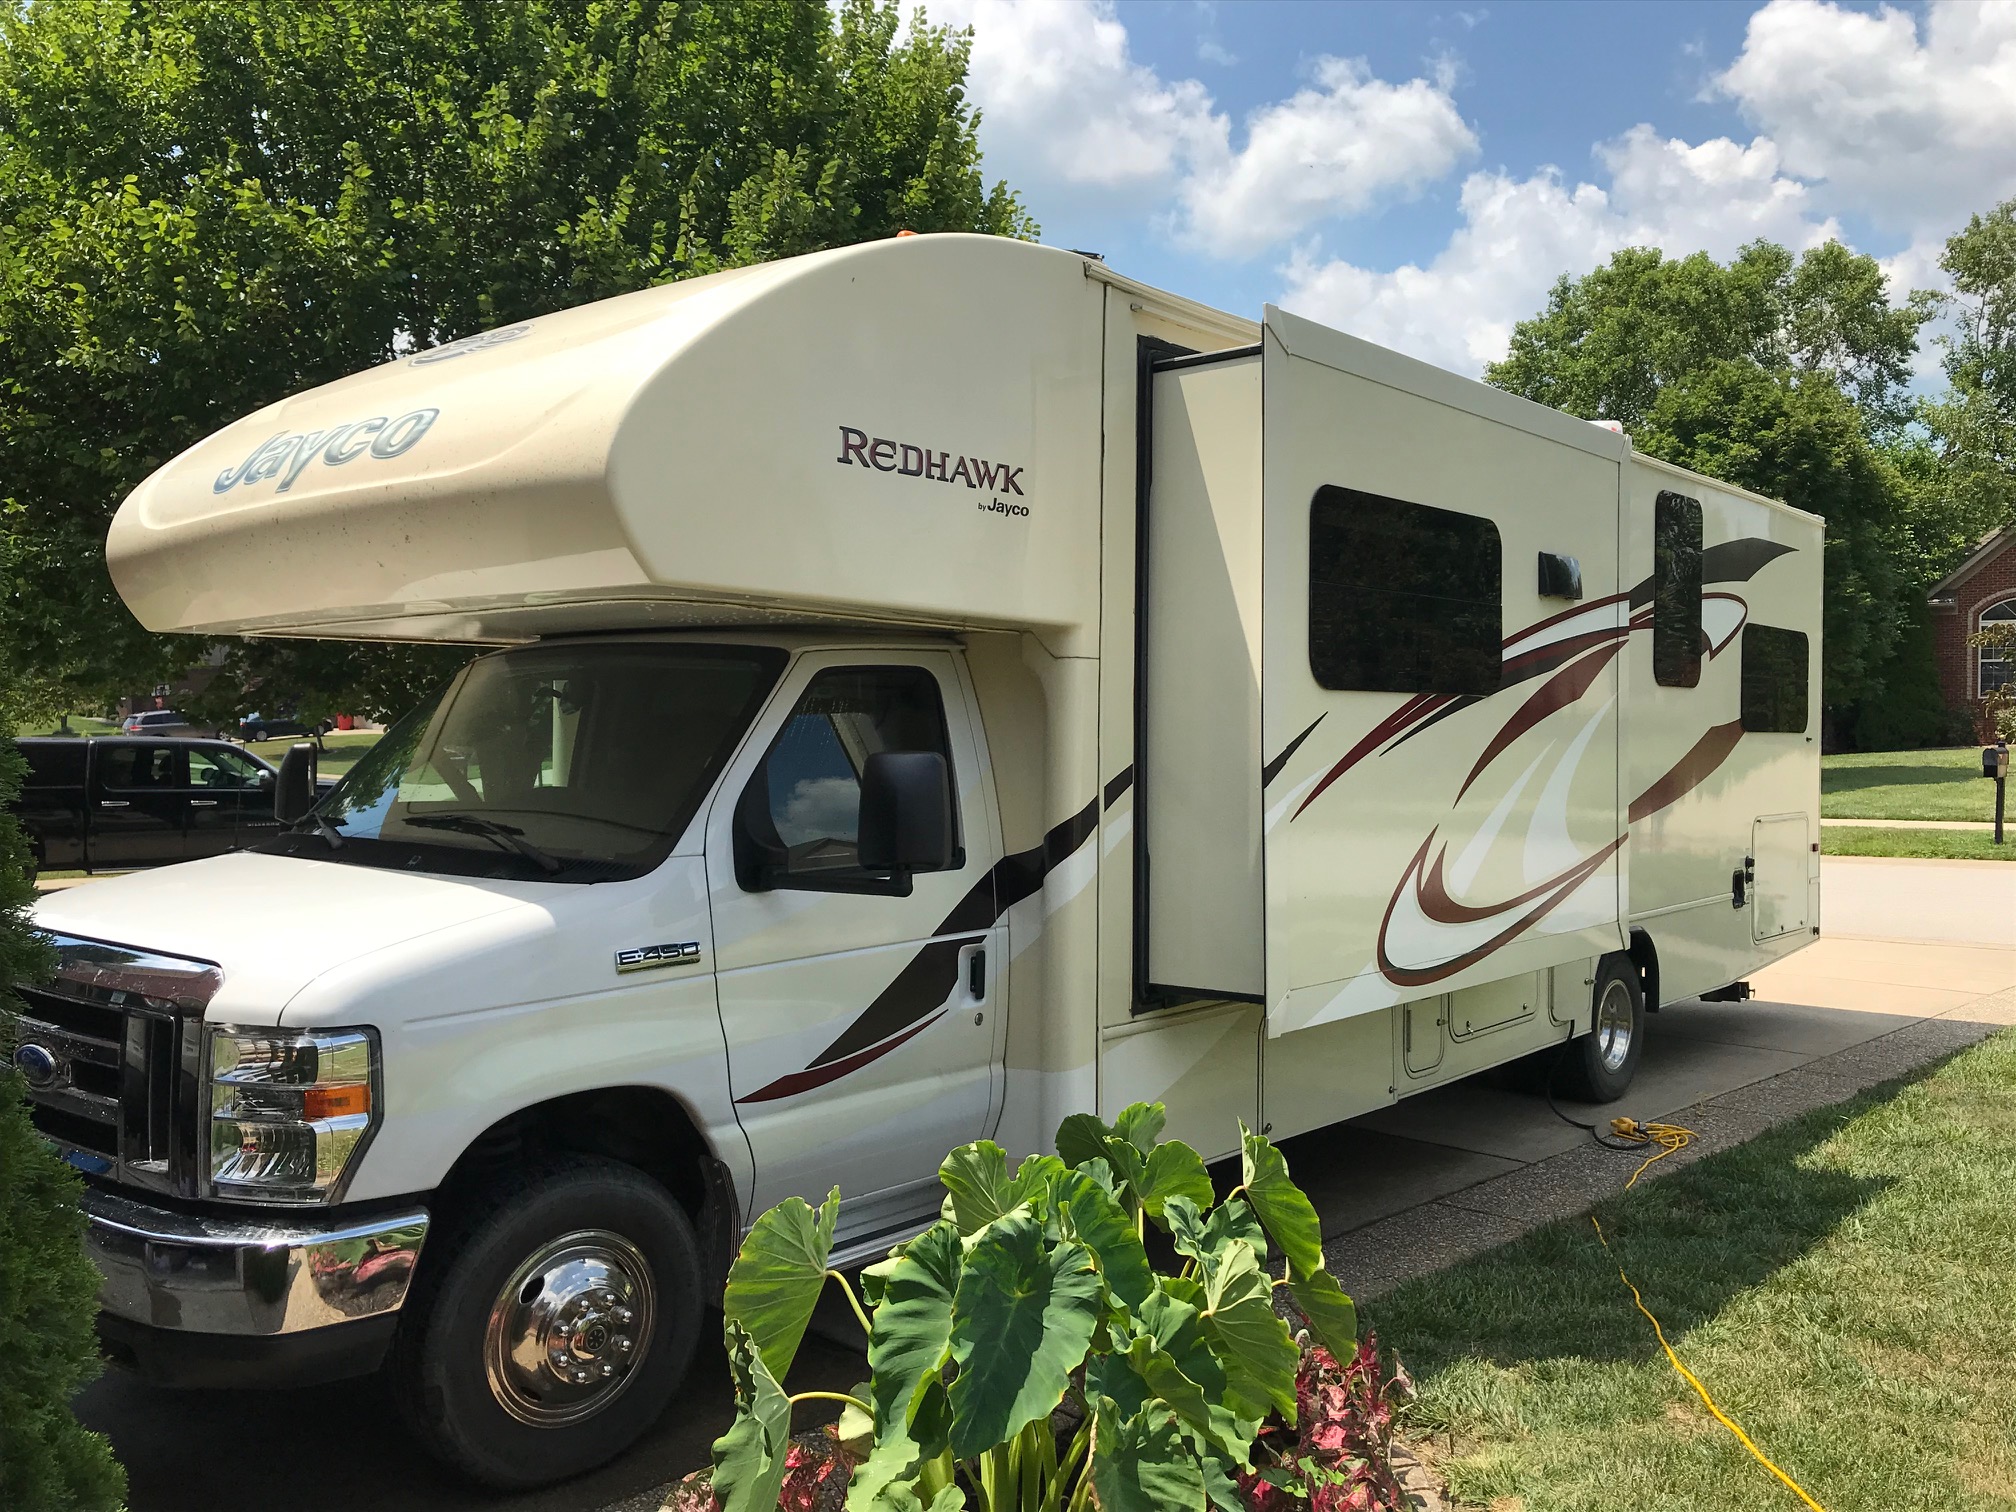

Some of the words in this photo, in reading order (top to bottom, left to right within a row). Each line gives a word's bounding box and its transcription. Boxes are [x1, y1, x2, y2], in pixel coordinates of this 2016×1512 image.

[213, 408, 440, 494] Jayco
[978, 502, 987, 512] by
[987, 497, 1030, 517] Jayco
